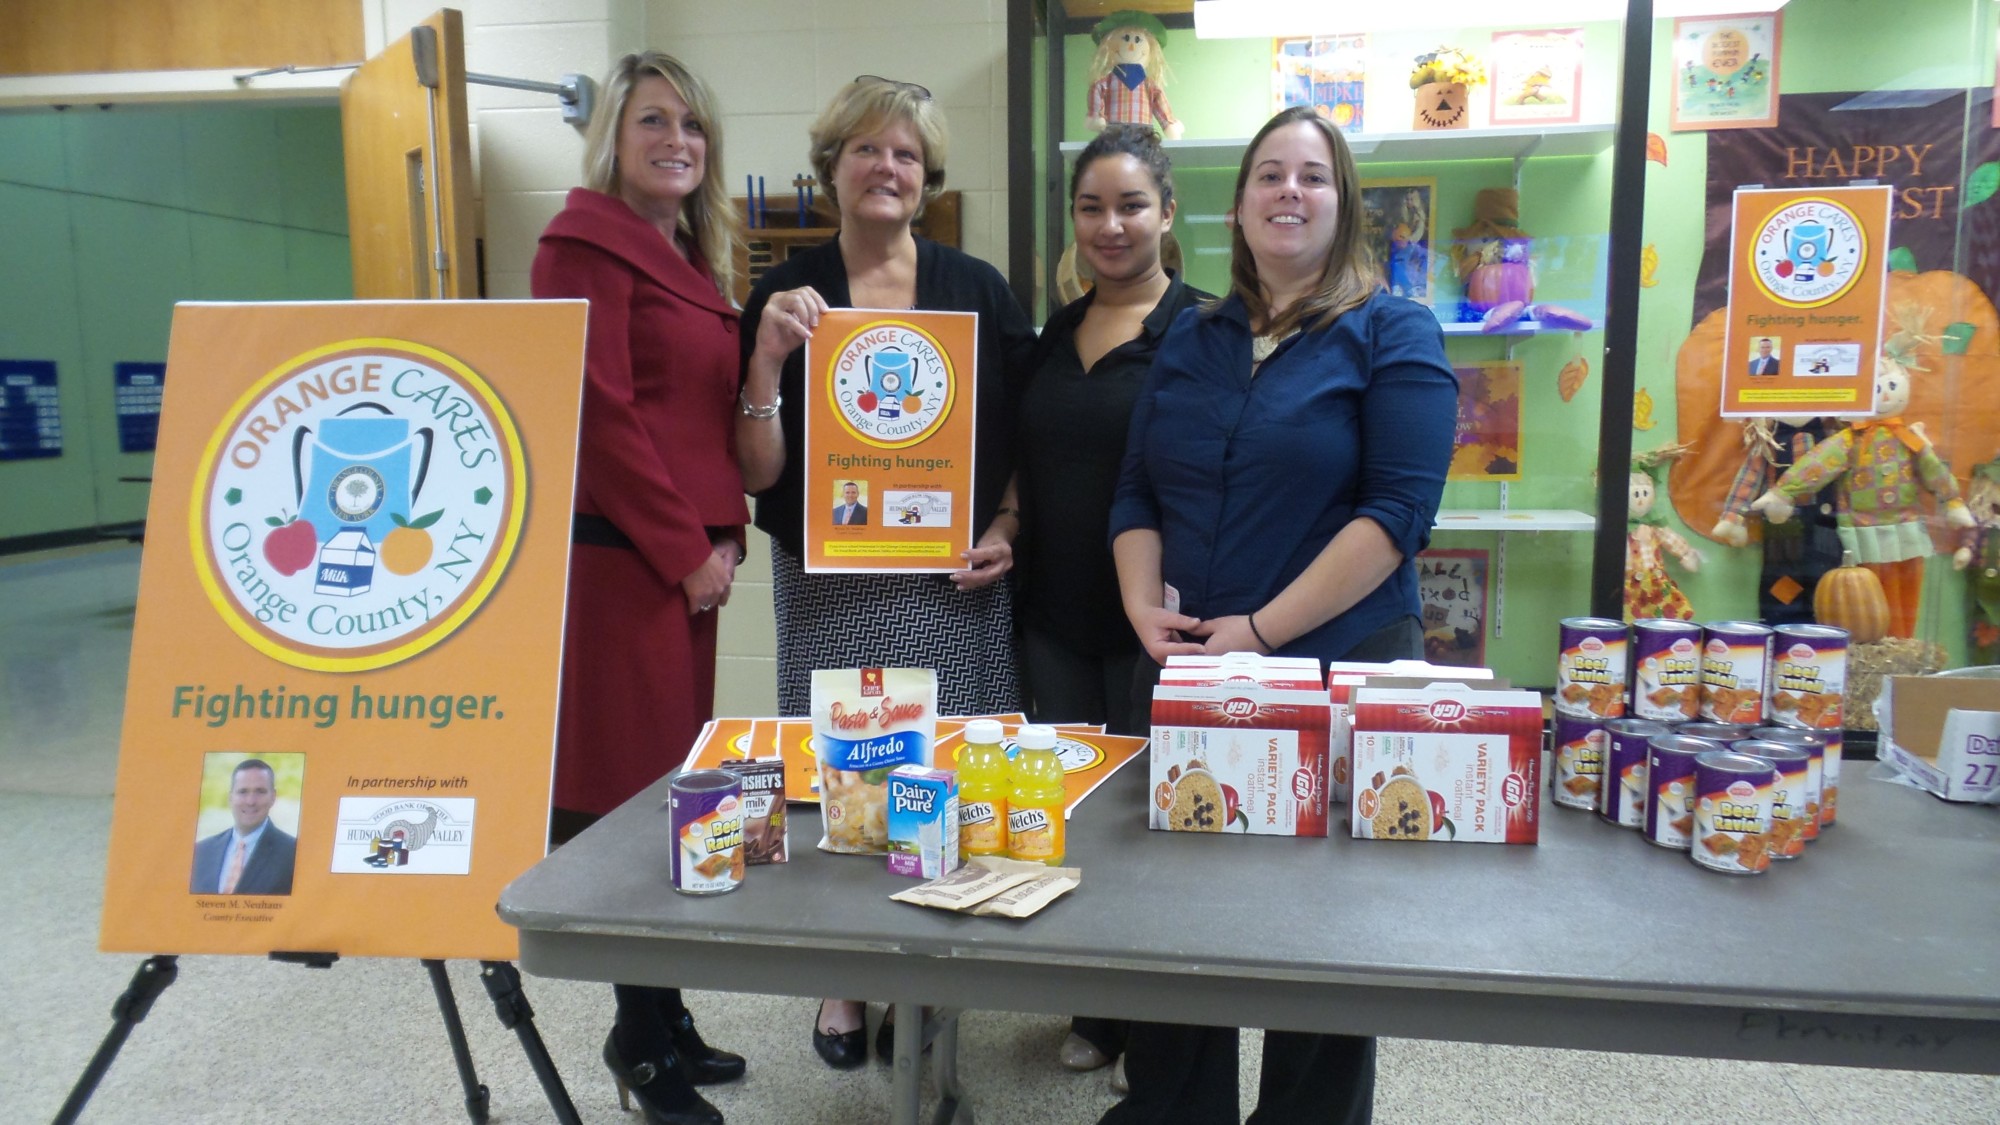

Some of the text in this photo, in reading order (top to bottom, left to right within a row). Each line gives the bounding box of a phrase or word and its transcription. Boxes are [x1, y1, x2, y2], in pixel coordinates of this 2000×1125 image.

[1784, 144, 1933, 178] HAPPY
[1762, 206, 1857, 244] ORANGE CARES
[1761, 260, 1790, 294] Orange
[1747, 313, 1863, 328] Fighting hunger.
[840, 331, 944, 374] ORANGE CARES
[231, 364, 497, 470] ORANGE CARES
[840, 391, 941, 435] Orange County, NY
[827, 454, 954, 471] Fighting hunger.
[223, 519, 486, 635] Orange County, NY
[320, 568, 349, 583] Milk
[1417, 559, 1462, 580] ALL
[1575, 656, 1608, 670] Beef
[1783, 662, 1820, 678] Beef
[1569, 668, 1612, 685] Ravioli
[1701, 669, 1738, 690] avioli
[1778, 675, 1825, 695] Ravioli
[172, 685, 504, 728] Fighting hunger.
[830, 696, 924, 731] Pasta & Sauce
[1226, 701, 1254, 714] IGA
[1434, 703, 1462, 718] IGA
[1162, 730, 1170, 740] 10
[1366, 736, 1374, 746] 10
[1966, 734, 2000, 756] Da
[847, 737, 904, 763] Alfredo
[1580, 748, 1603, 763] Be
[347, 776, 468, 790] In partnership with
[742, 773, 782, 789] RSHEY'S
[1257, 758, 1265, 792] instant
[1266, 738, 1278, 825] VARIETY PACK
[1296, 771, 1310, 796] IGA
[1465, 764, 1473, 799] instant
[892, 781, 936, 802] Dairy
[1163, 792, 1170, 800] 7
[1247, 773, 1256, 814] oatmeal
[1475, 743, 1487, 832] VARIETY PACK
[1507, 776, 1520, 803] IGA
[746, 798, 767, 809] milk
[896, 796, 932, 813] Pure
[1368, 799, 1375, 808] 7
[1454, 779, 1462, 821] oatmeal
[1720, 802, 1759, 818] Beef
[373, 807, 393, 821] FOOD
[831, 806, 839, 819] 8
[1009, 810, 1044, 830] Welch's
[711, 815, 741, 836] Beef
[1712, 814, 1763, 835] Ravioli
[347, 829, 465, 842] HUDSON VALLEY
[704, 830, 743, 854] Raviol
[196, 900, 226, 909] Steven
[203, 913, 274, 922] County Executive
